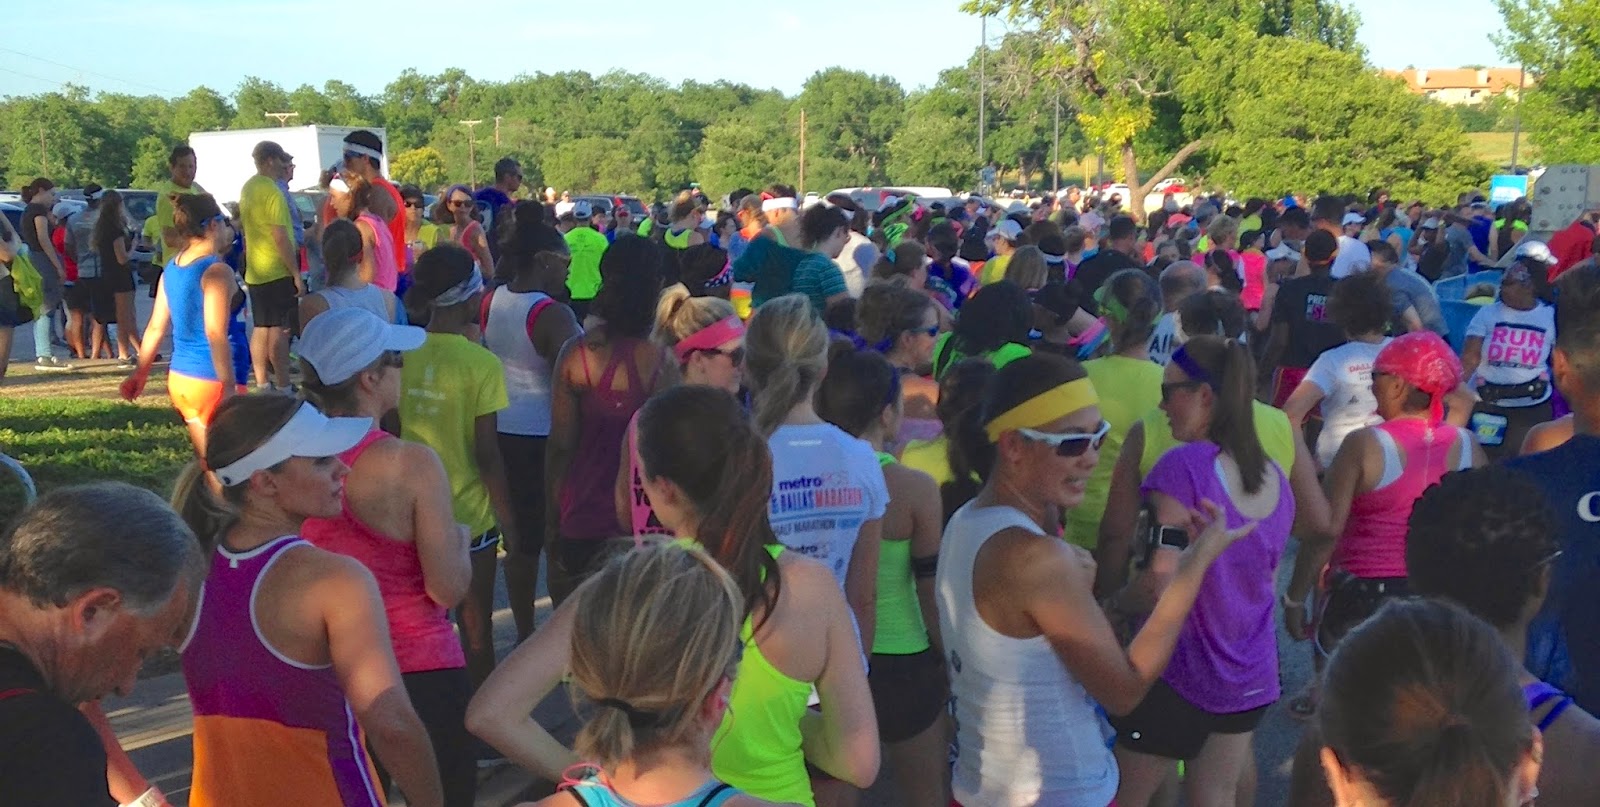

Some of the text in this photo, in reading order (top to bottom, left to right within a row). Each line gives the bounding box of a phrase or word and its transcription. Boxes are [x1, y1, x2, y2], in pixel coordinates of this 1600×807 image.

[1491, 327, 1545, 349] RUN
[1488, 344, 1541, 365] DFW
[780, 489, 815, 513] DALLAS
